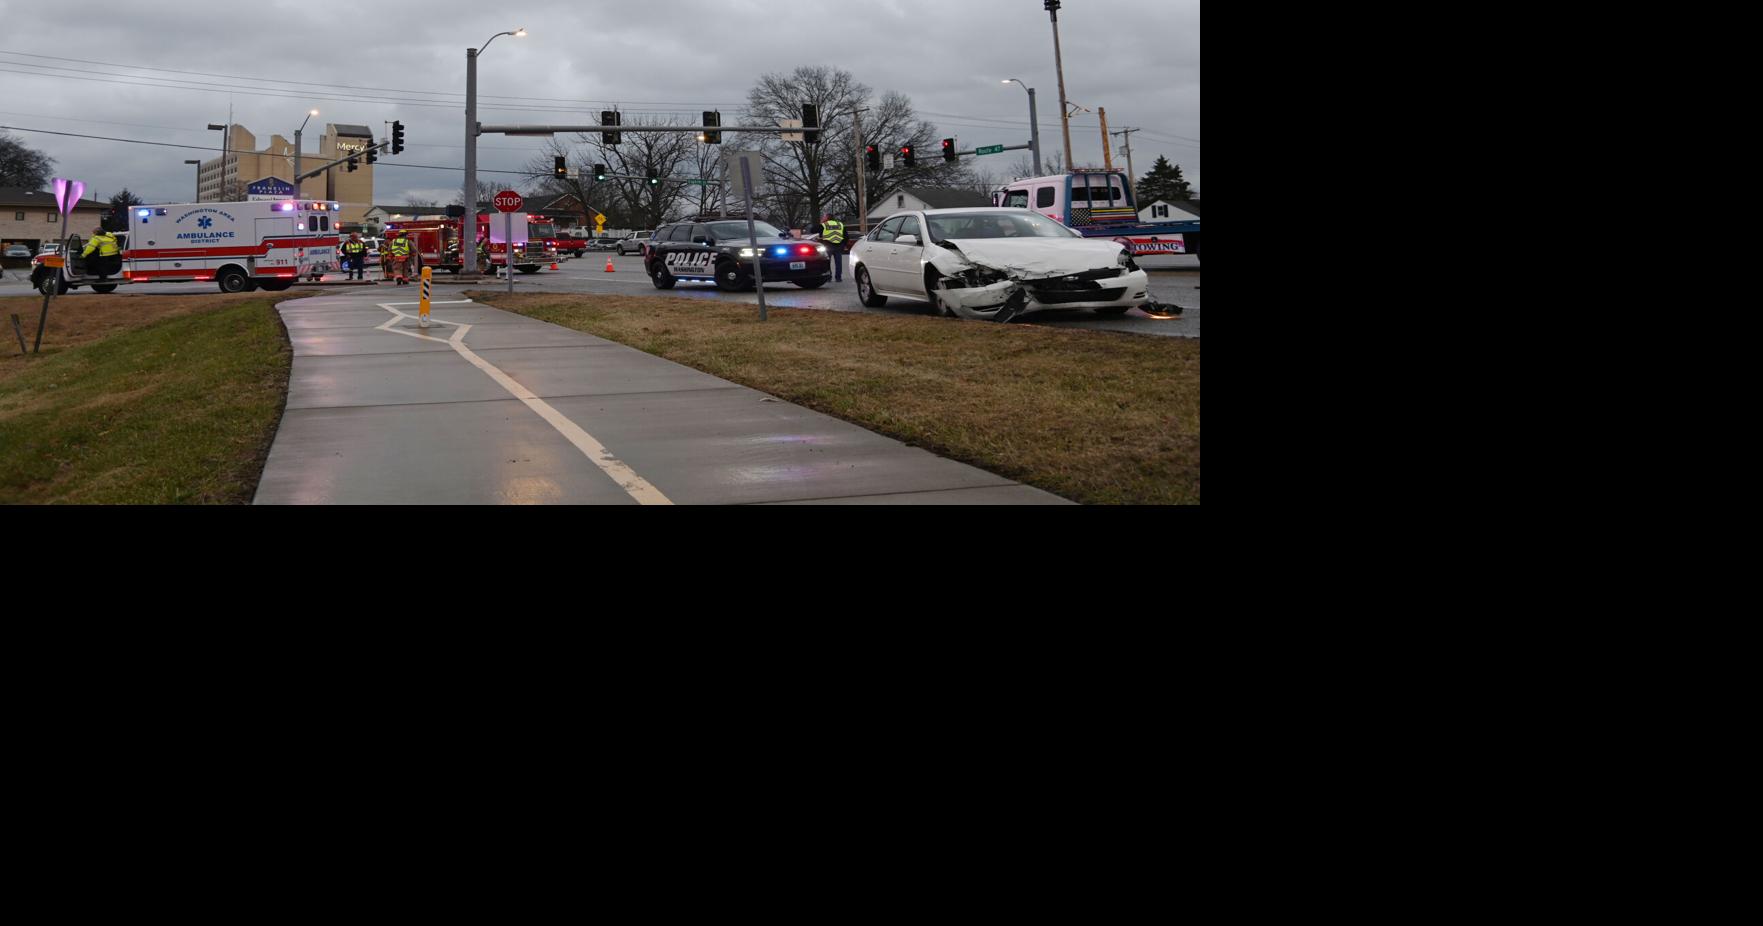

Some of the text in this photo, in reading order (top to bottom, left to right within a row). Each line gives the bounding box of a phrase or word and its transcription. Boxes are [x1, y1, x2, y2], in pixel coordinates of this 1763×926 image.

[336, 142, 366, 152] Mercy
[495, 197, 521, 206] STOP
[176, 208, 235, 224] WASHINGTON AREA
[1133, 242, 1179, 251] TOWING
[665, 252, 718, 267] POLICE
